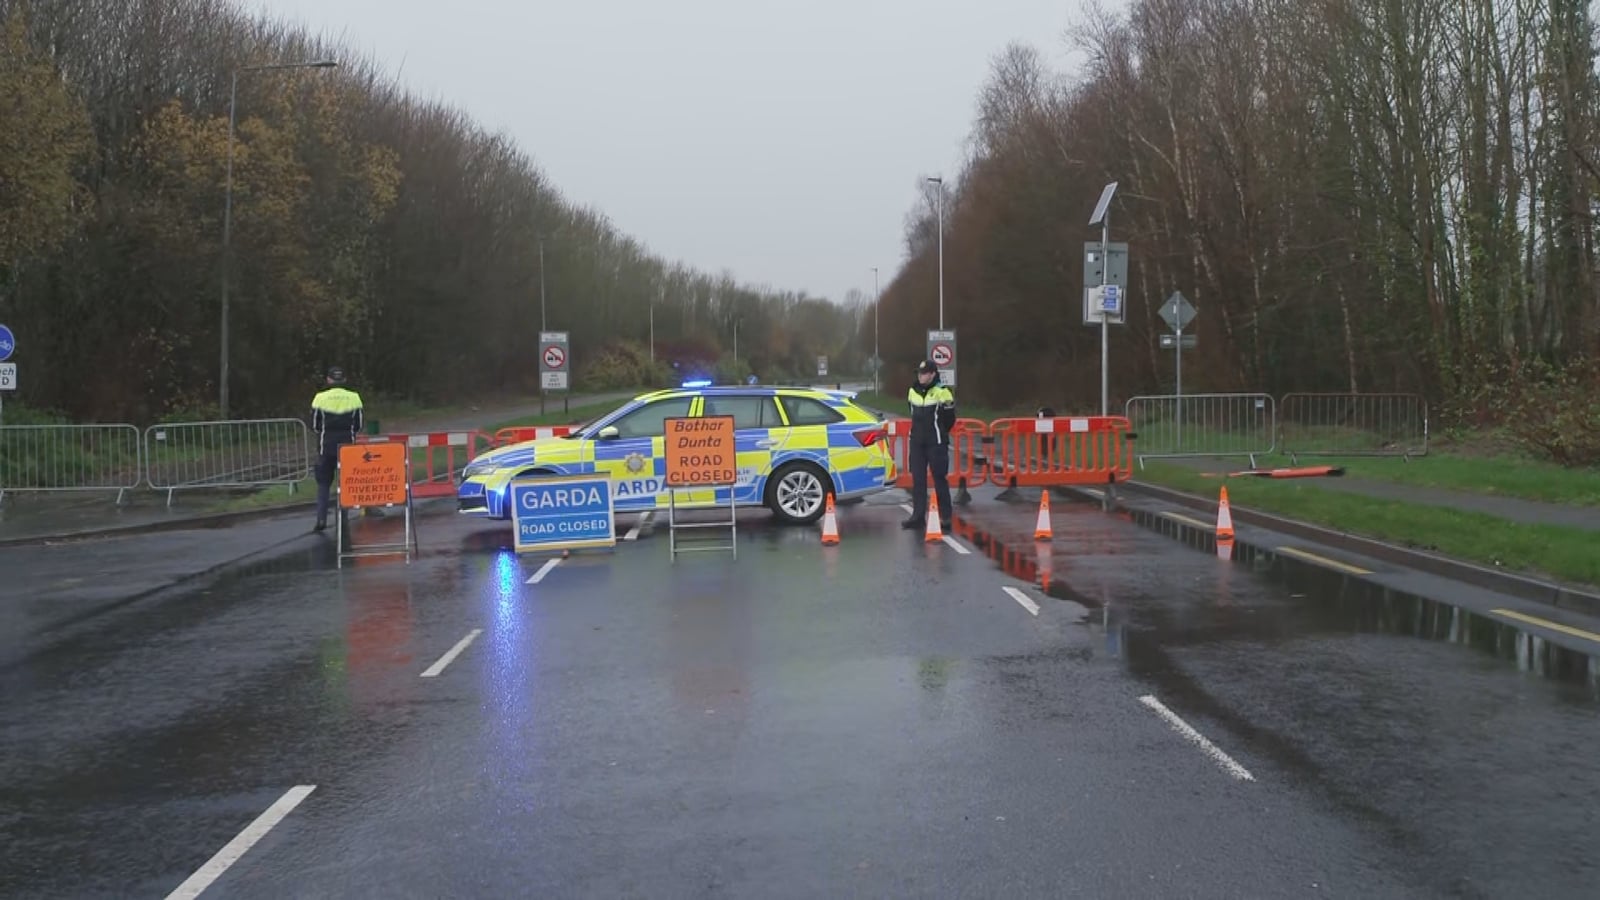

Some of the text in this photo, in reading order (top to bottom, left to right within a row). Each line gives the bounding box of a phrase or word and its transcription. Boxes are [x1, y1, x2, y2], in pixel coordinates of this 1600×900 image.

[678, 435, 722, 448] Dunta
[680, 454, 723, 467] ROAD
[670, 469, 733, 482] CLOSED
[348, 483, 398, 494] DIVERTED
[352, 493, 394, 503] TRAFFIC
[522, 487, 602, 509] GARDA
[521, 519, 607, 535] ROAD CLOSED
